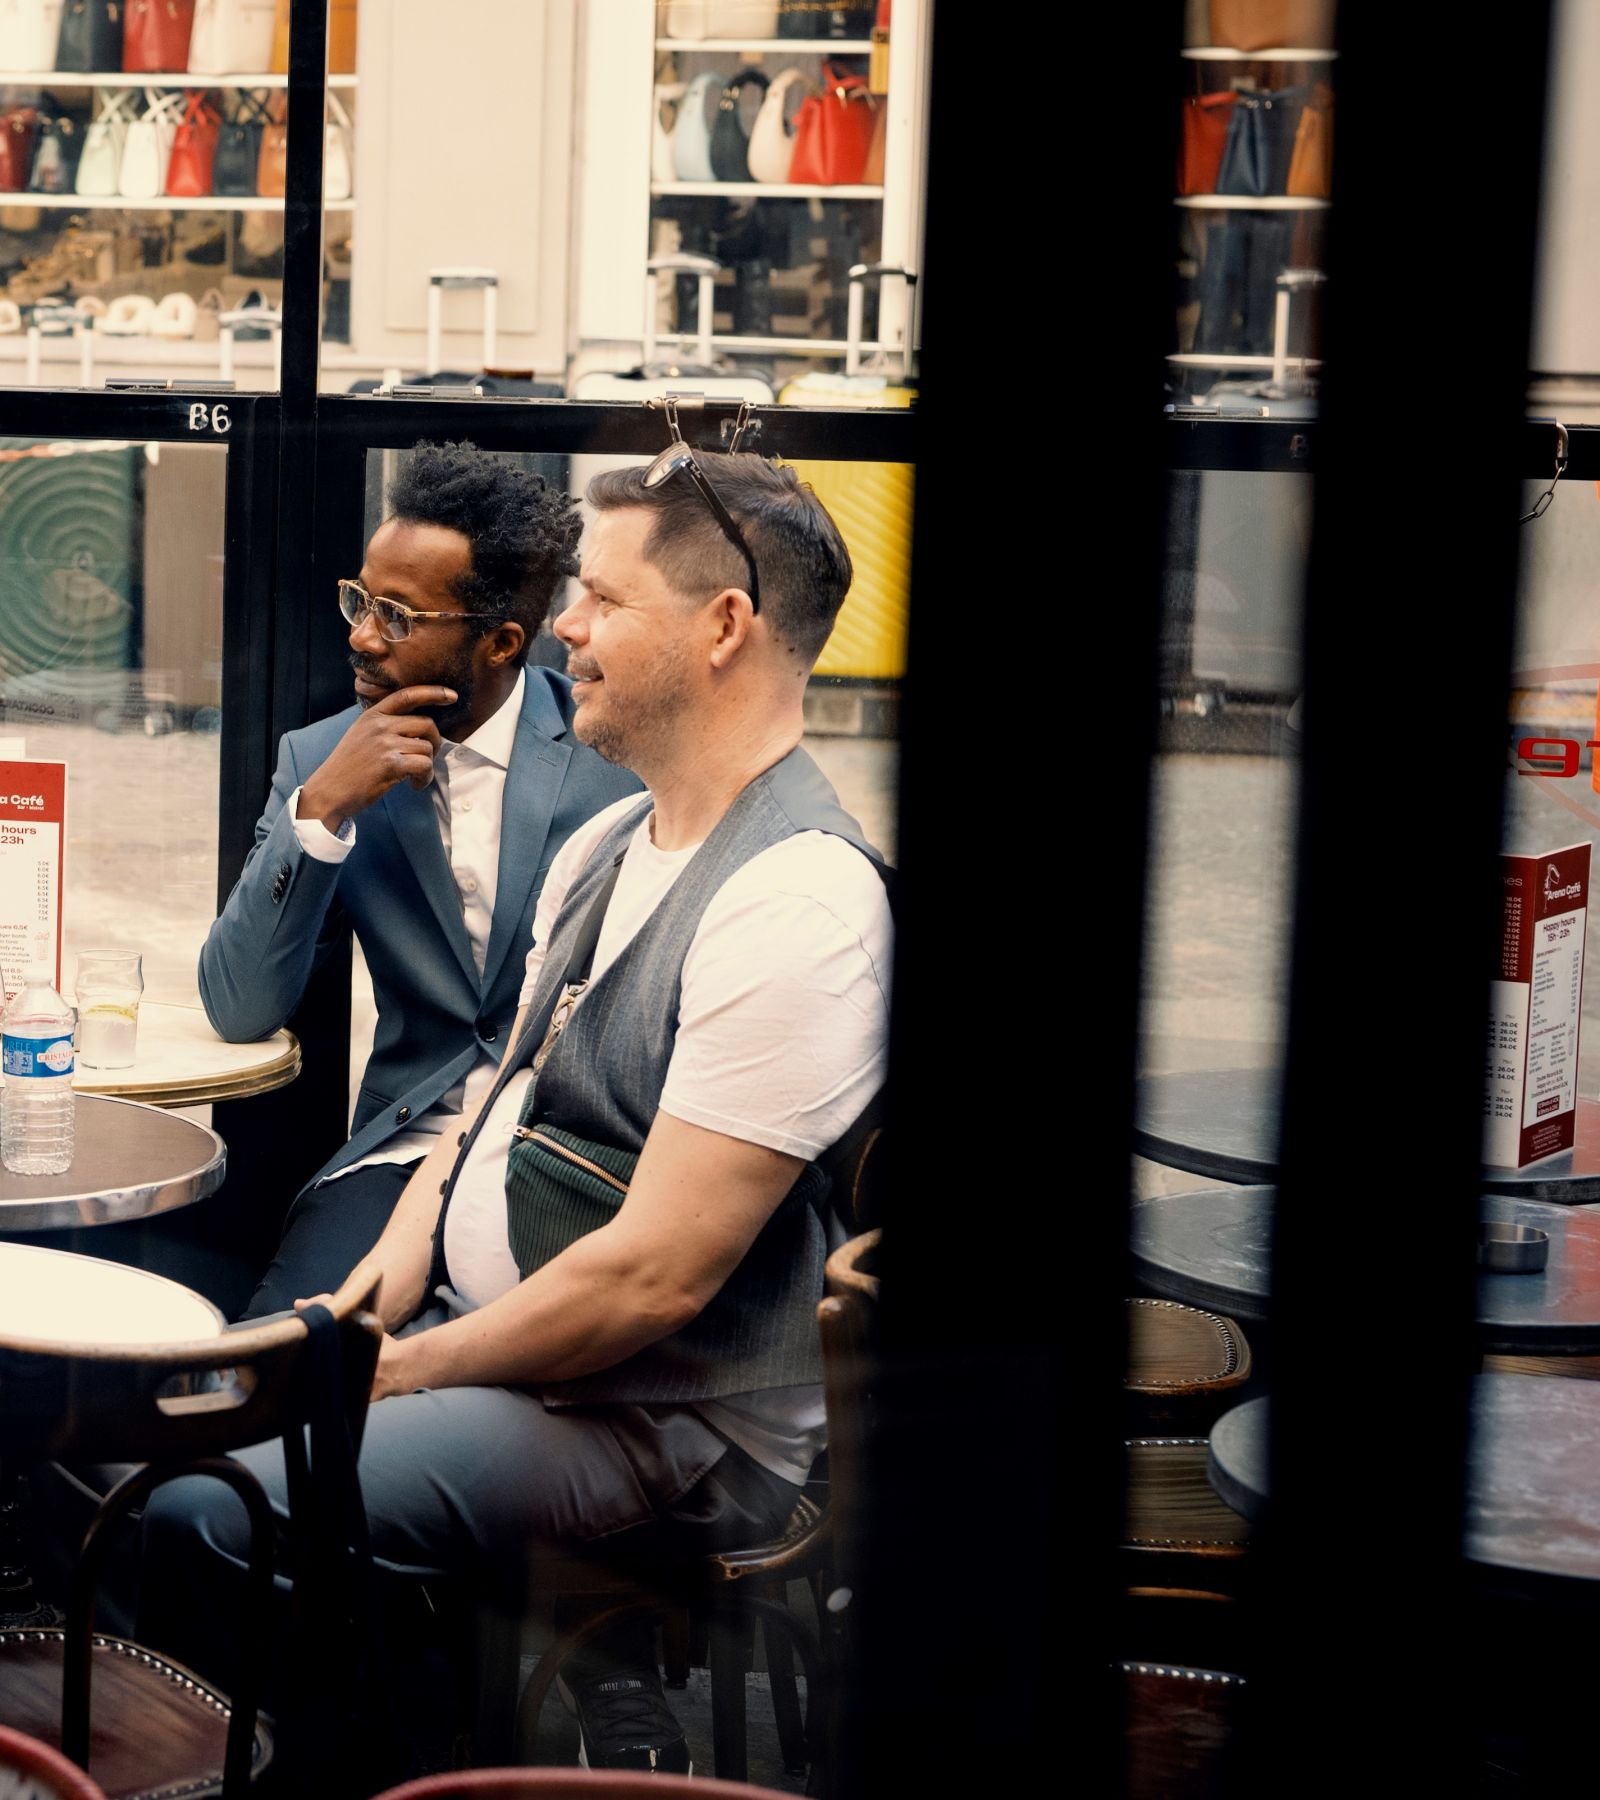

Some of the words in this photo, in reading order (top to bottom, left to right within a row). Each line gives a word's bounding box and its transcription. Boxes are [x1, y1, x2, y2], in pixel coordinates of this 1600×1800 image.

[190, 403, 232, 433] B6
[10, 794, 44, 805] Café
[1, 825, 37, 835] hours
[0, 836, 24, 845] 23h
[1547, 889, 1566, 900] Arena
[1566, 881, 1581, 895] Café
[1543, 920, 1560, 932] Happy
[1560, 916, 1576, 926] hours
[1560, 928, 1570, 939] 23h
